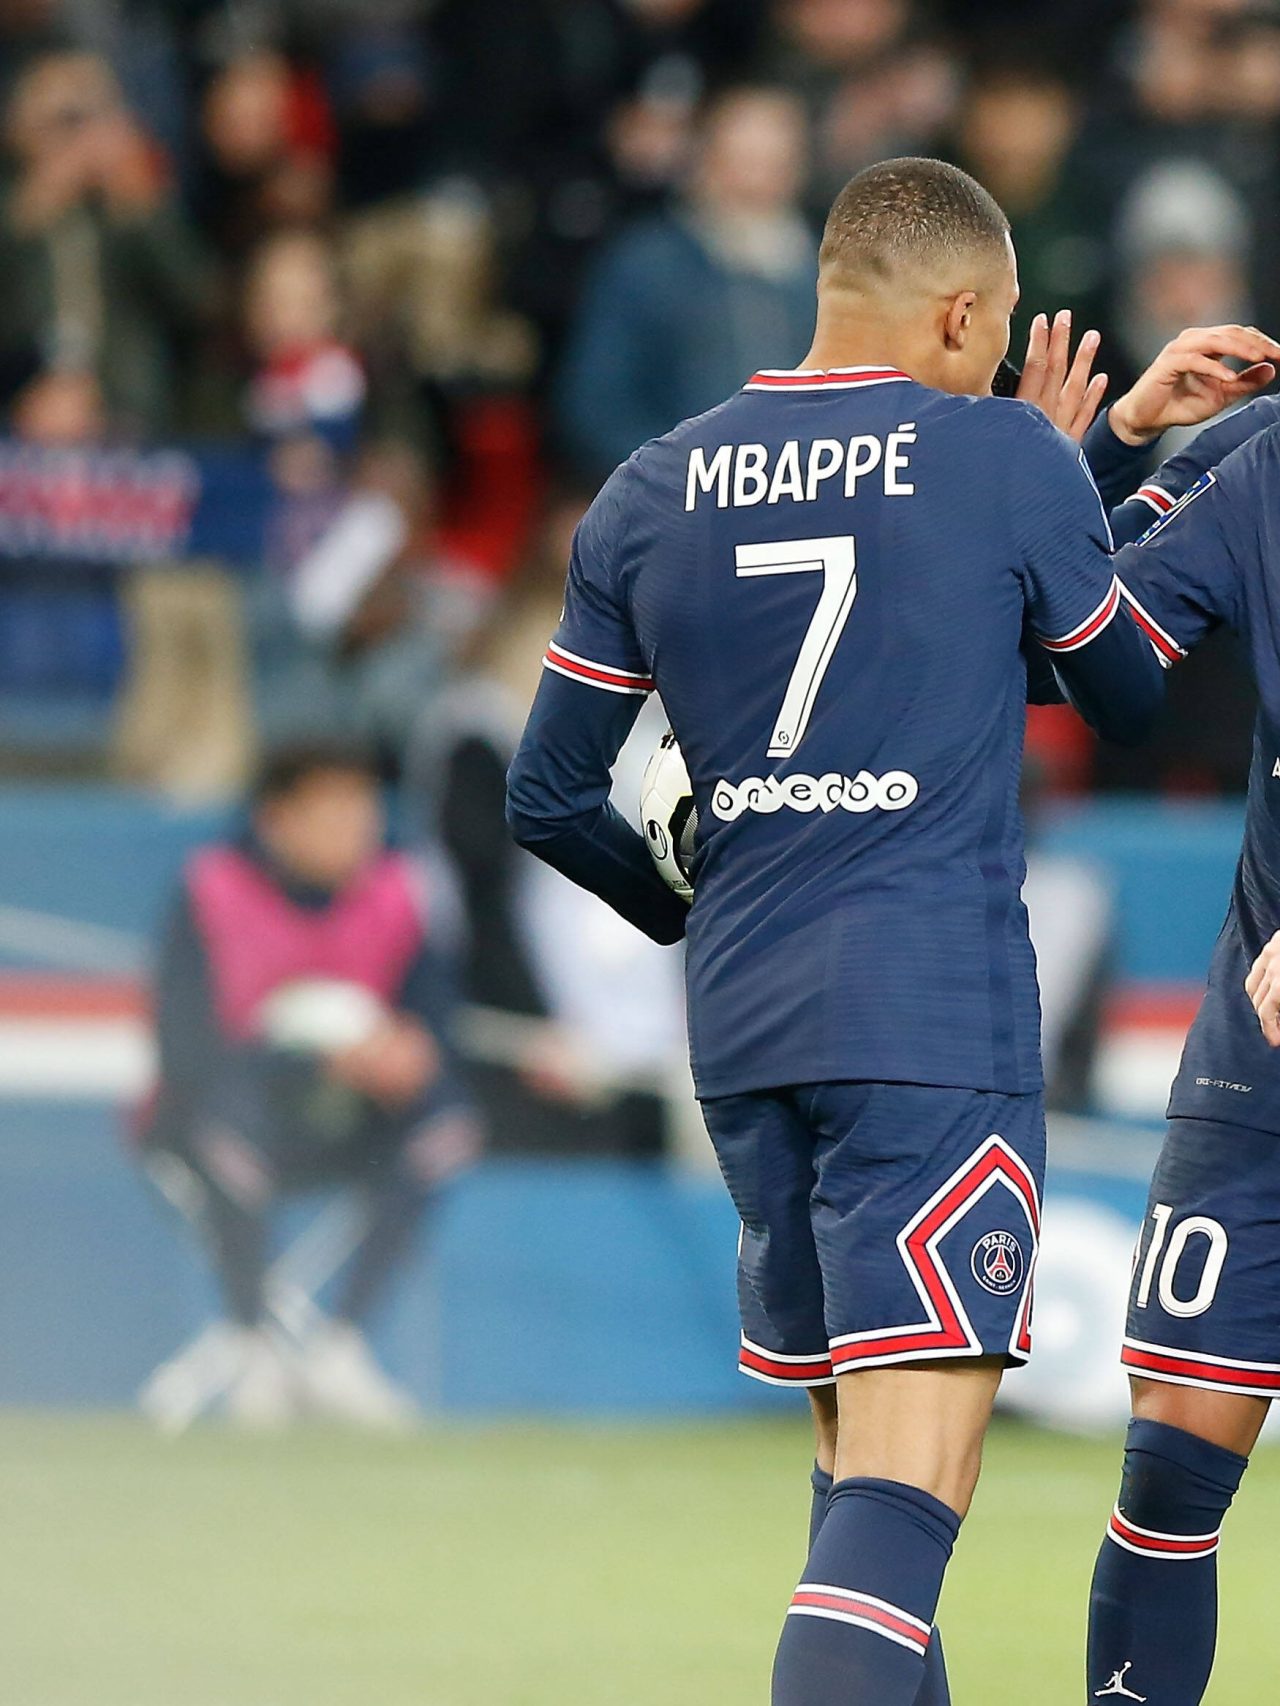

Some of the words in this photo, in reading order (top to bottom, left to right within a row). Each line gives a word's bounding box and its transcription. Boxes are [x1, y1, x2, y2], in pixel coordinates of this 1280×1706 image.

[685, 422, 917, 511] MBAPPÉ
[735, 535, 858, 758] 7
[982, 1234, 1017, 1252] PARIS
[1136, 1203, 1228, 1318] 10
